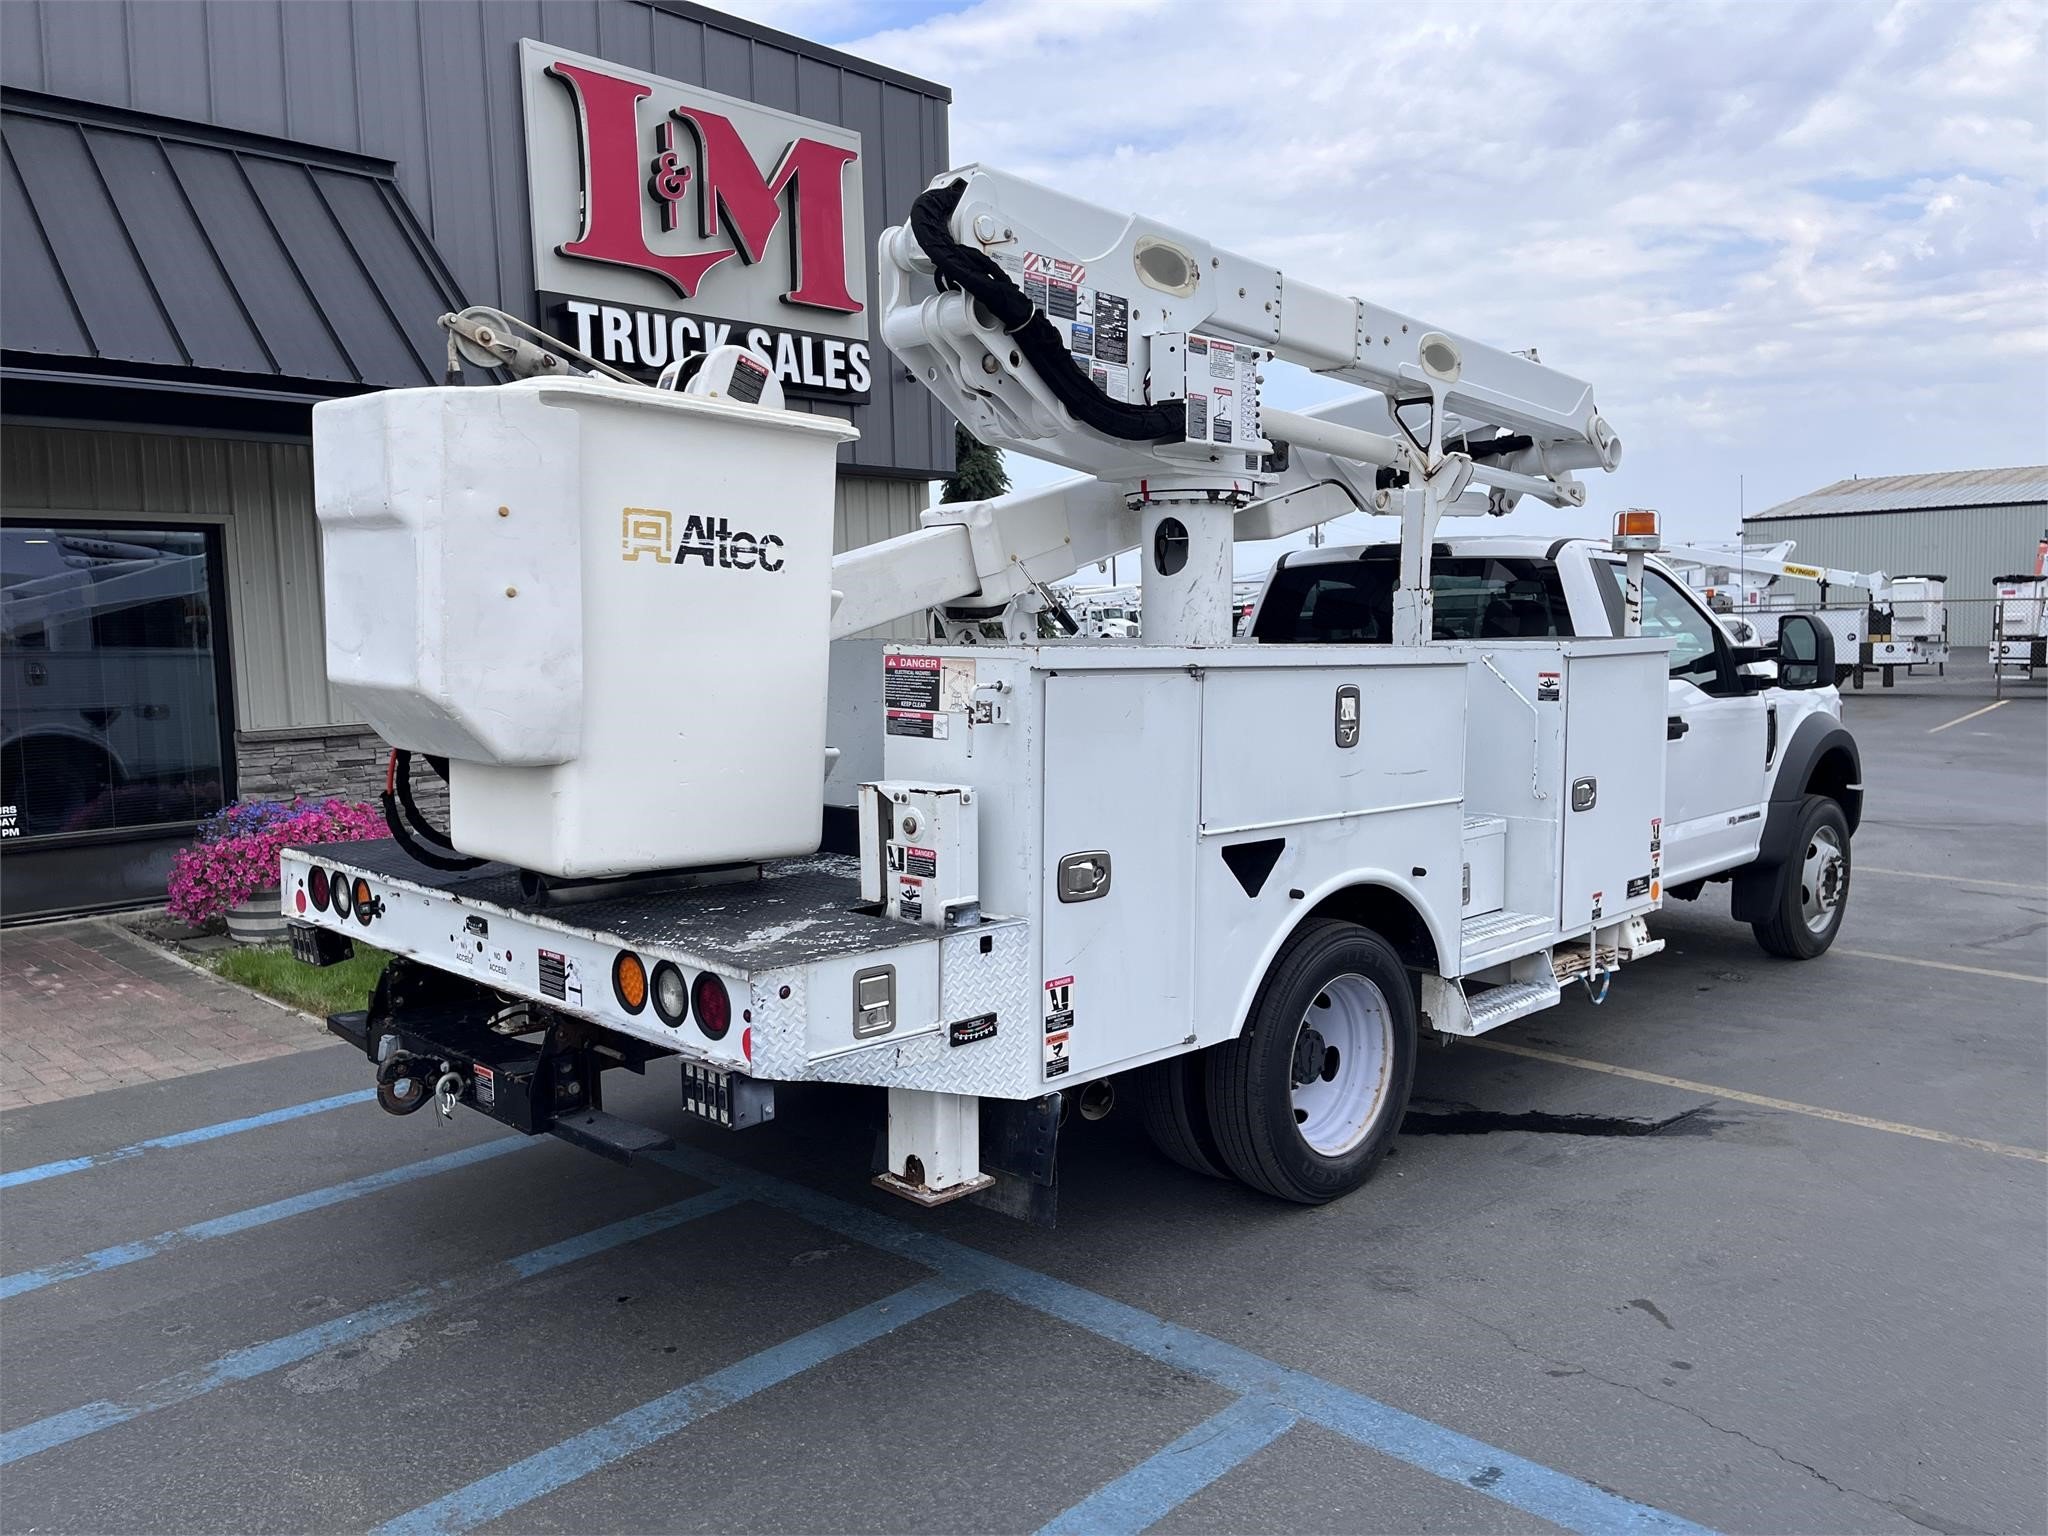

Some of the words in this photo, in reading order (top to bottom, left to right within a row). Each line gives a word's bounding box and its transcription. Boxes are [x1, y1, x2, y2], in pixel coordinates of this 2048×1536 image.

[745, 328, 871, 393] SALES
[674, 515, 785, 572] Altec
[900, 659, 937, 669] DANGER
[0, 806, 17, 814] RS
[0, 817, 16, 826] AY
[2, 828, 20, 837] PM
[494, 952, 502, 961] NO
[489, 963, 507, 976] ACCESS
